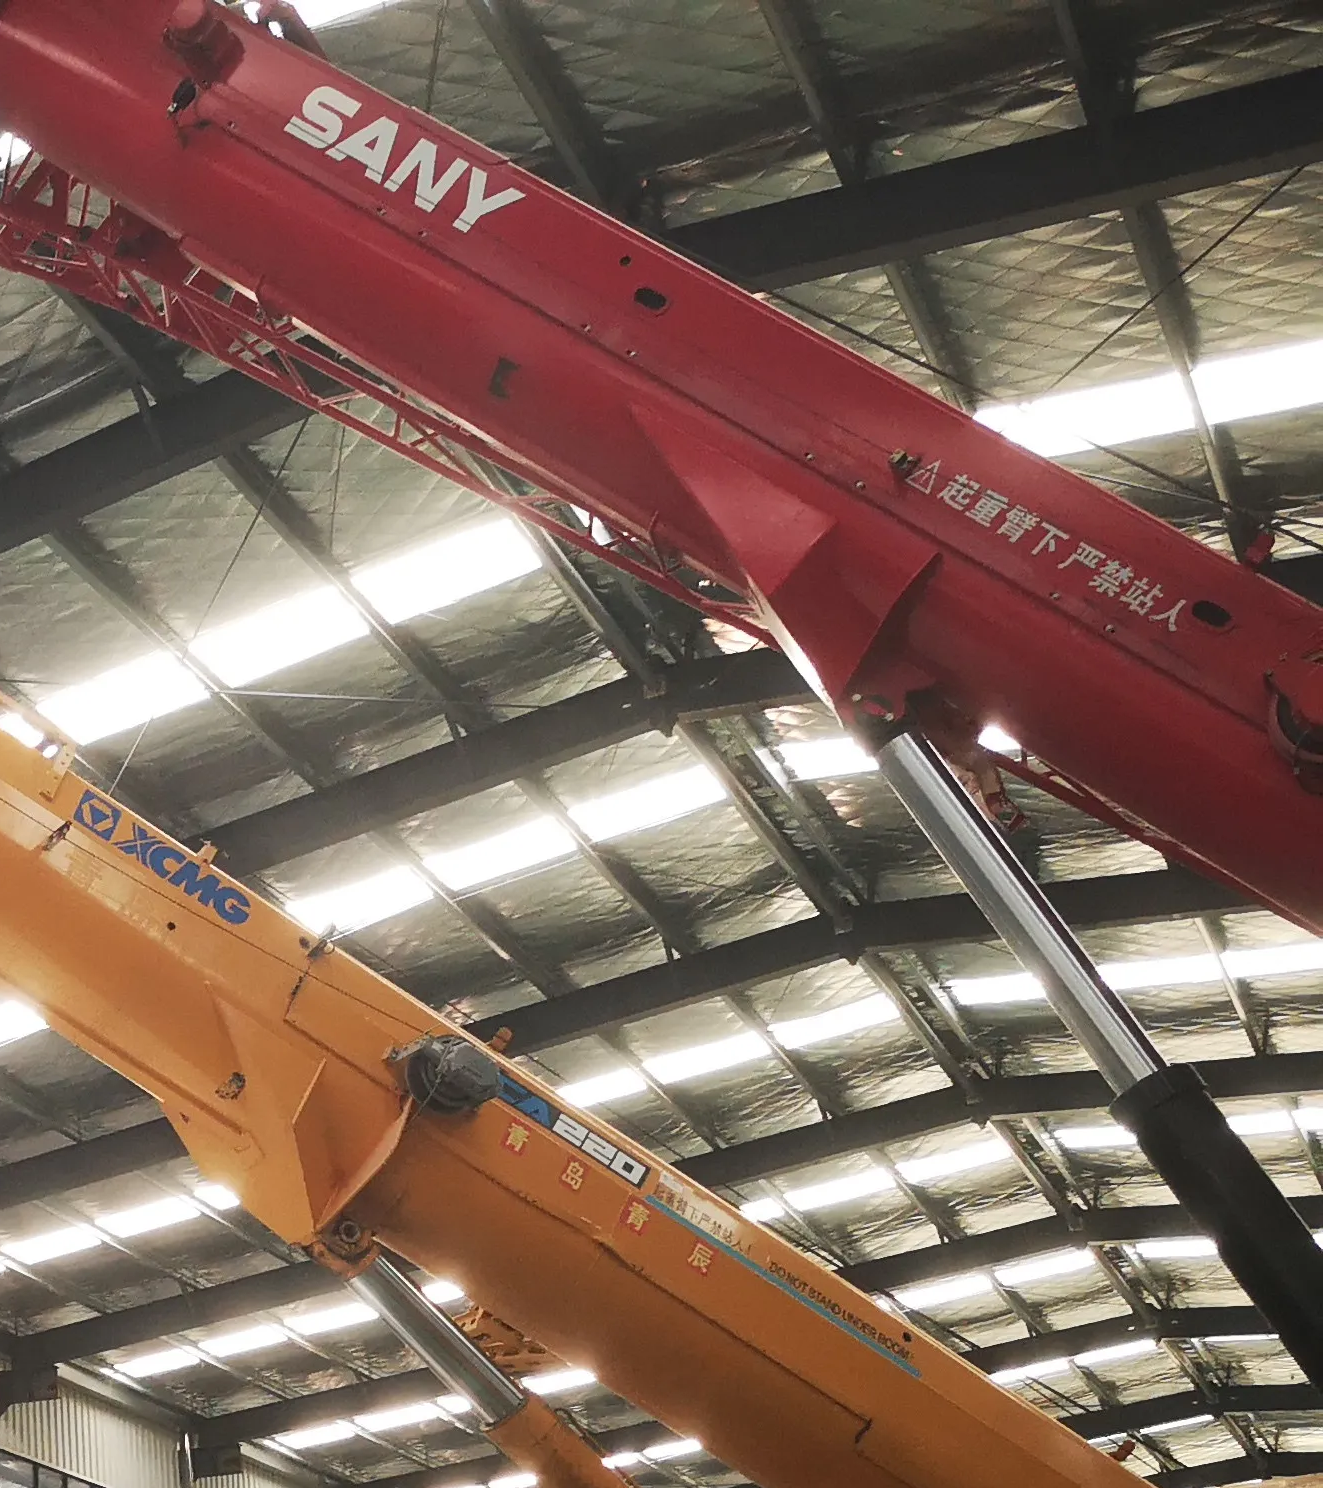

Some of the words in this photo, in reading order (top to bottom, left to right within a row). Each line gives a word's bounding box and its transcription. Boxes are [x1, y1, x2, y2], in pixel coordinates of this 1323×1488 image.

[284, 86, 526, 233] SANY
[111, 822, 251, 925] XCMG
[767, 1260, 787, 1279] DO
[786, 1270, 810, 1296] NOT
[808, 1286, 842, 1317] STAND
[841, 1309, 878, 1340] UNDER
